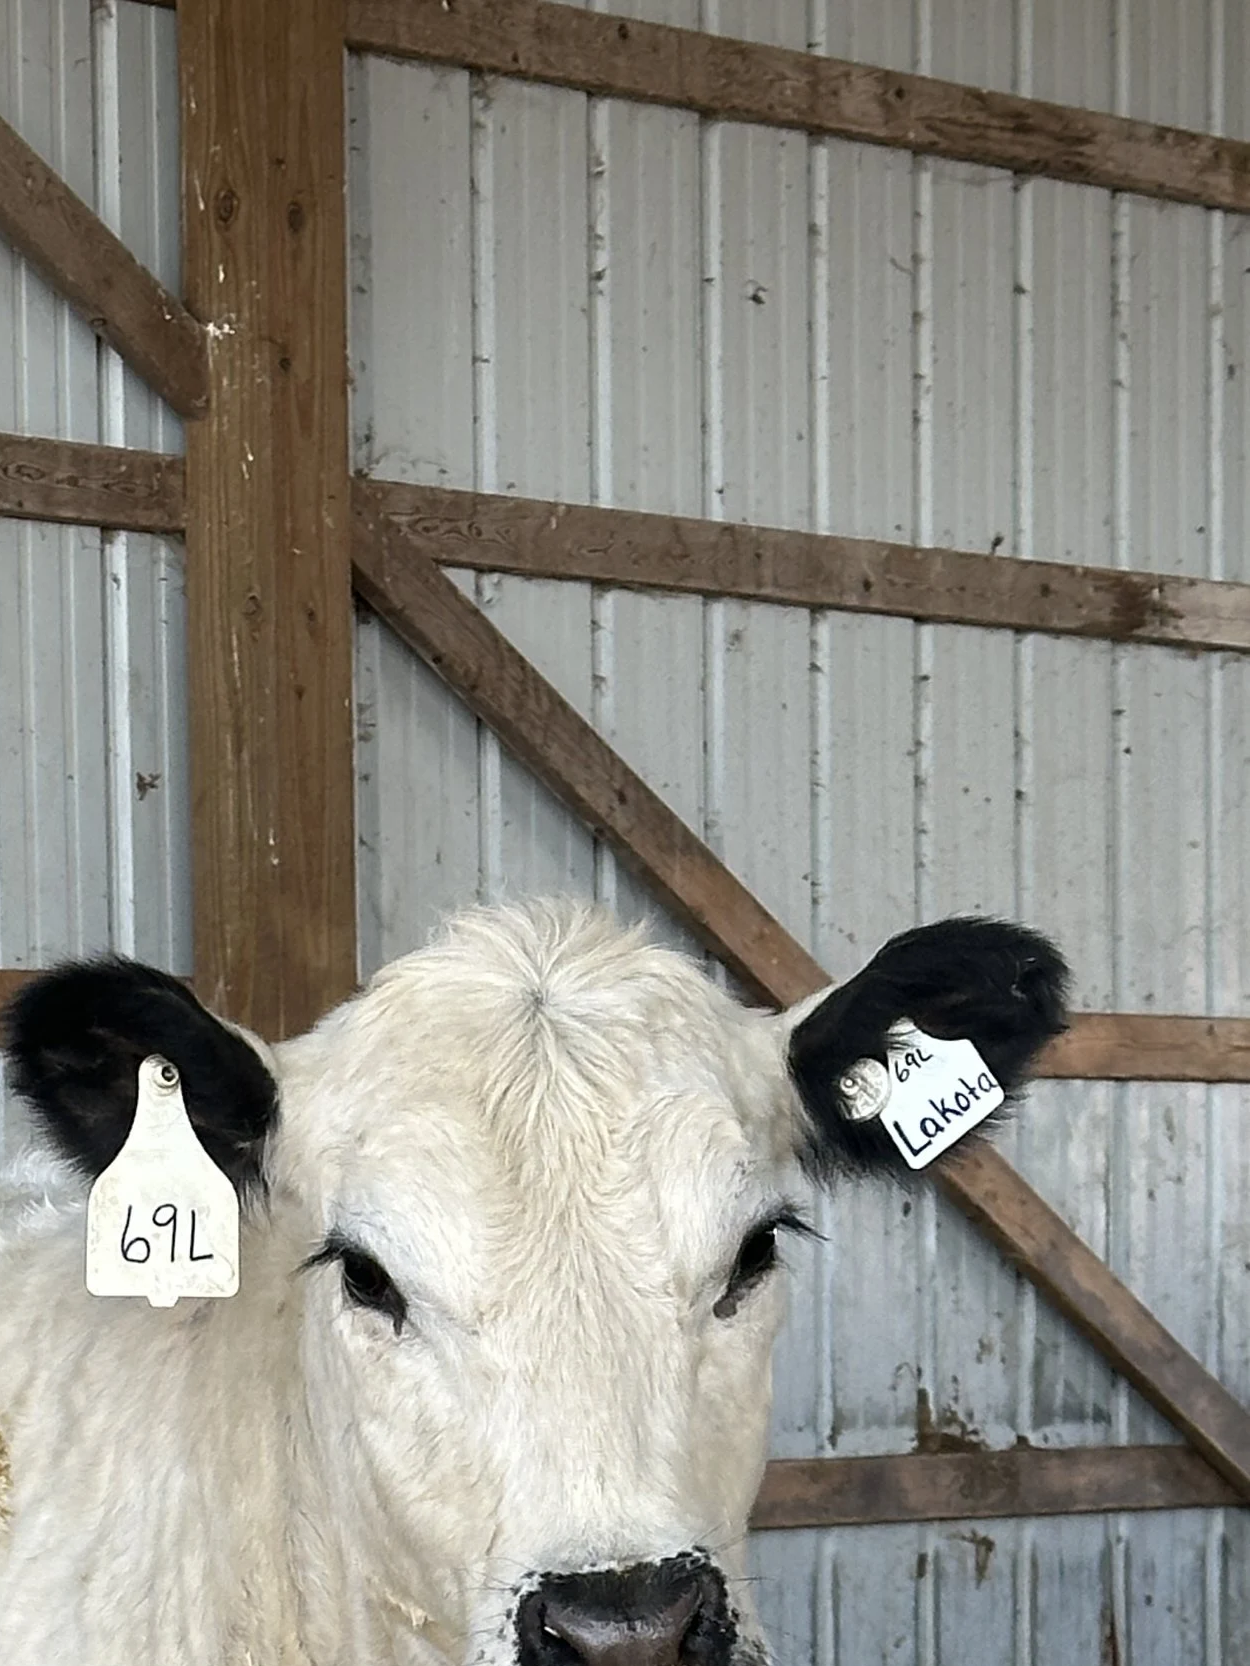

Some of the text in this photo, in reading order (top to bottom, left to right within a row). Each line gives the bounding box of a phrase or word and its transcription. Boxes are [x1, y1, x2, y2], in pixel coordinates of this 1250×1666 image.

[894, 1048, 934, 1083] 69L
[893, 1072, 999, 1157] Lakota
[121, 1203, 213, 1264] 69L
